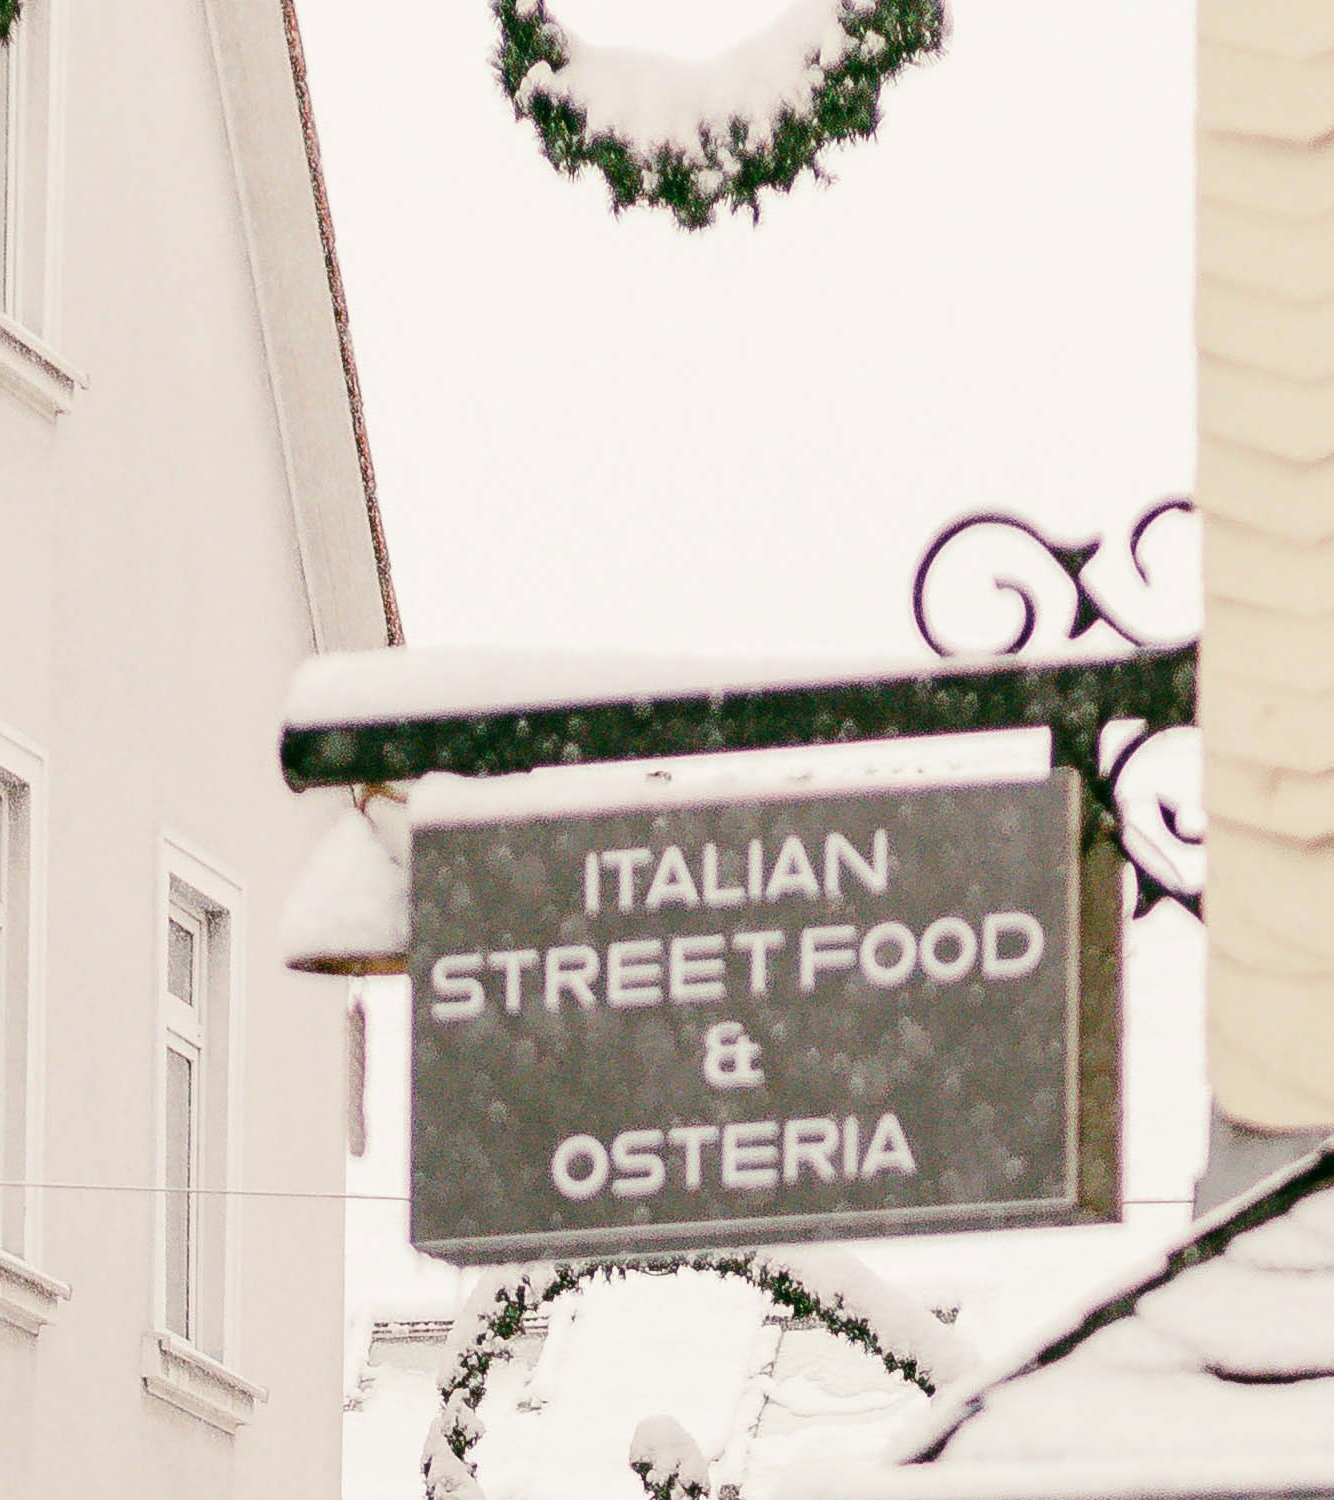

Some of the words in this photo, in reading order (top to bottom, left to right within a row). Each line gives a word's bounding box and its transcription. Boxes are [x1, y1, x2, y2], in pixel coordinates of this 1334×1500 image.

[584, 828, 890, 915] ITALIAN
[703, 1022, 764, 1087] &
[551, 1113, 917, 1201] OSTERIA
